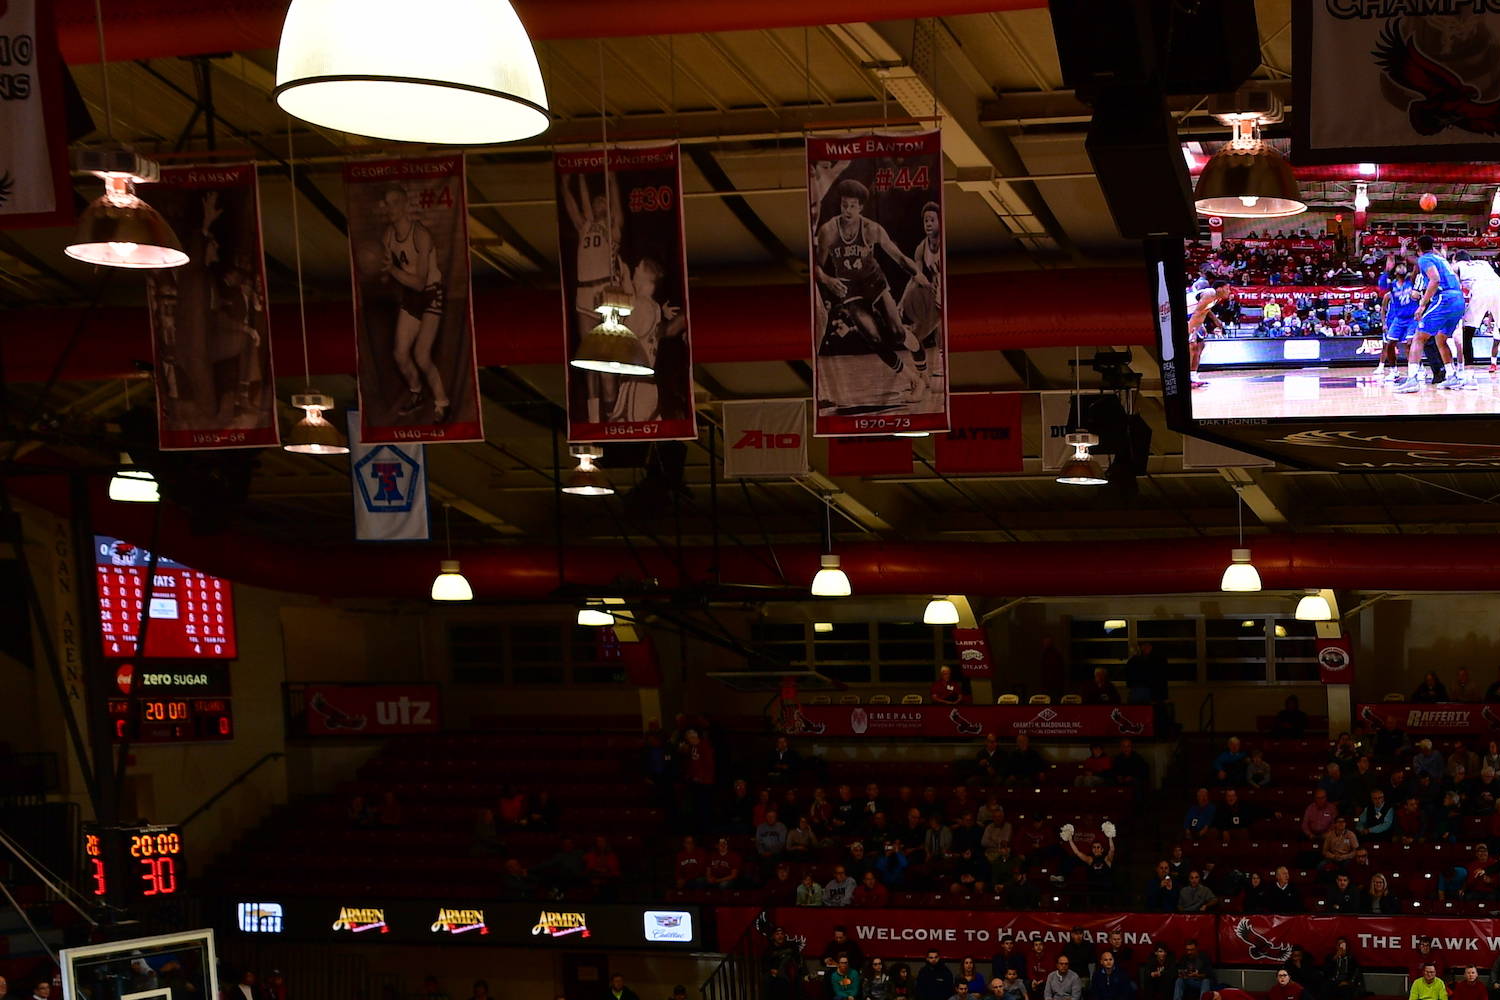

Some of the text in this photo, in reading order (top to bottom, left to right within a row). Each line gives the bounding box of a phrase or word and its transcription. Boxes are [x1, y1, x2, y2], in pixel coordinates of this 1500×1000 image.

[615, 151, 674, 166] ANDERSON
[825, 140, 924, 156] MIKE BANTOM
[188, 171, 240, 184] RAMSAY
[874, 166, 929, 192] #44
[419, 187, 453, 209] #4
[628, 185, 673, 211] #30
[732, 430, 802, 450] A10
[143, 672, 171, 685] zero
[173, 674, 208, 685] SUGAR
[376, 697, 432, 726] utz
[870, 712, 923, 720] EMERALD
[1407, 709, 1470, 727] RAFFERTY
[131, 832, 179, 857] 20:00
[141, 857, 177, 896] 30
[333, 906, 384, 932] ARMEN
[431, 907, 484, 933] ARMEN
[532, 910, 586, 935] ARMEN
[856, 925, 961, 942] WELCOME
[964, 930, 990, 942] TO
[1082, 929, 1153, 945] ARNA
[1357, 934, 1402, 949] THE
